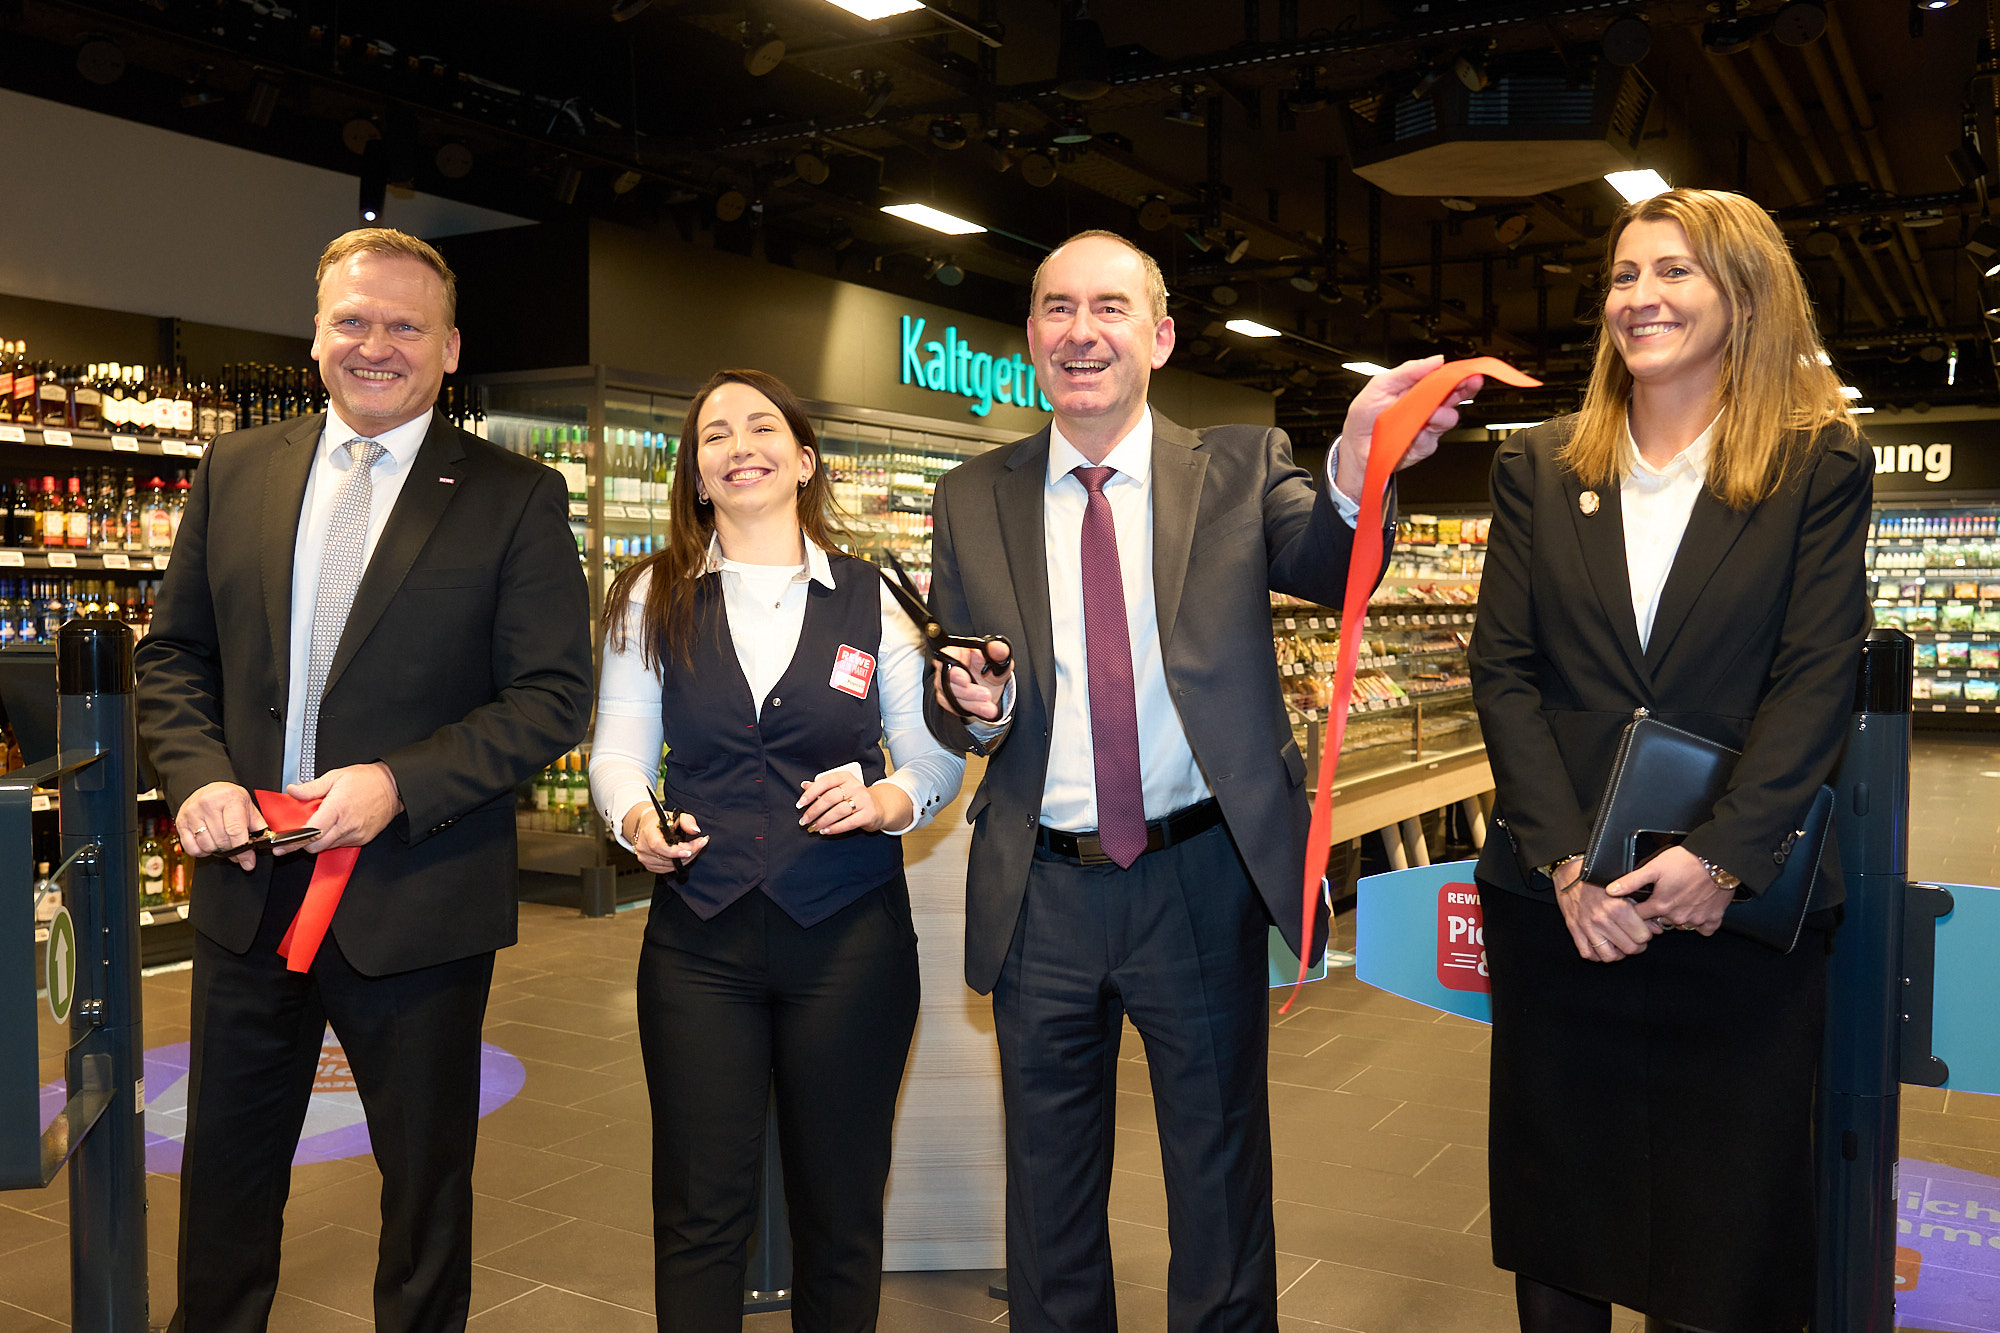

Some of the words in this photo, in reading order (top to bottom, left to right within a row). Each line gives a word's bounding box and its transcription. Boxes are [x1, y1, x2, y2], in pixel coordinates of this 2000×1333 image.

[901, 315, 1053, 417] Kaltgetr
[1872, 443, 1952, 482] ung
[841, 650, 871, 669] REWE
[1897, 1189, 2000, 1223] ich
